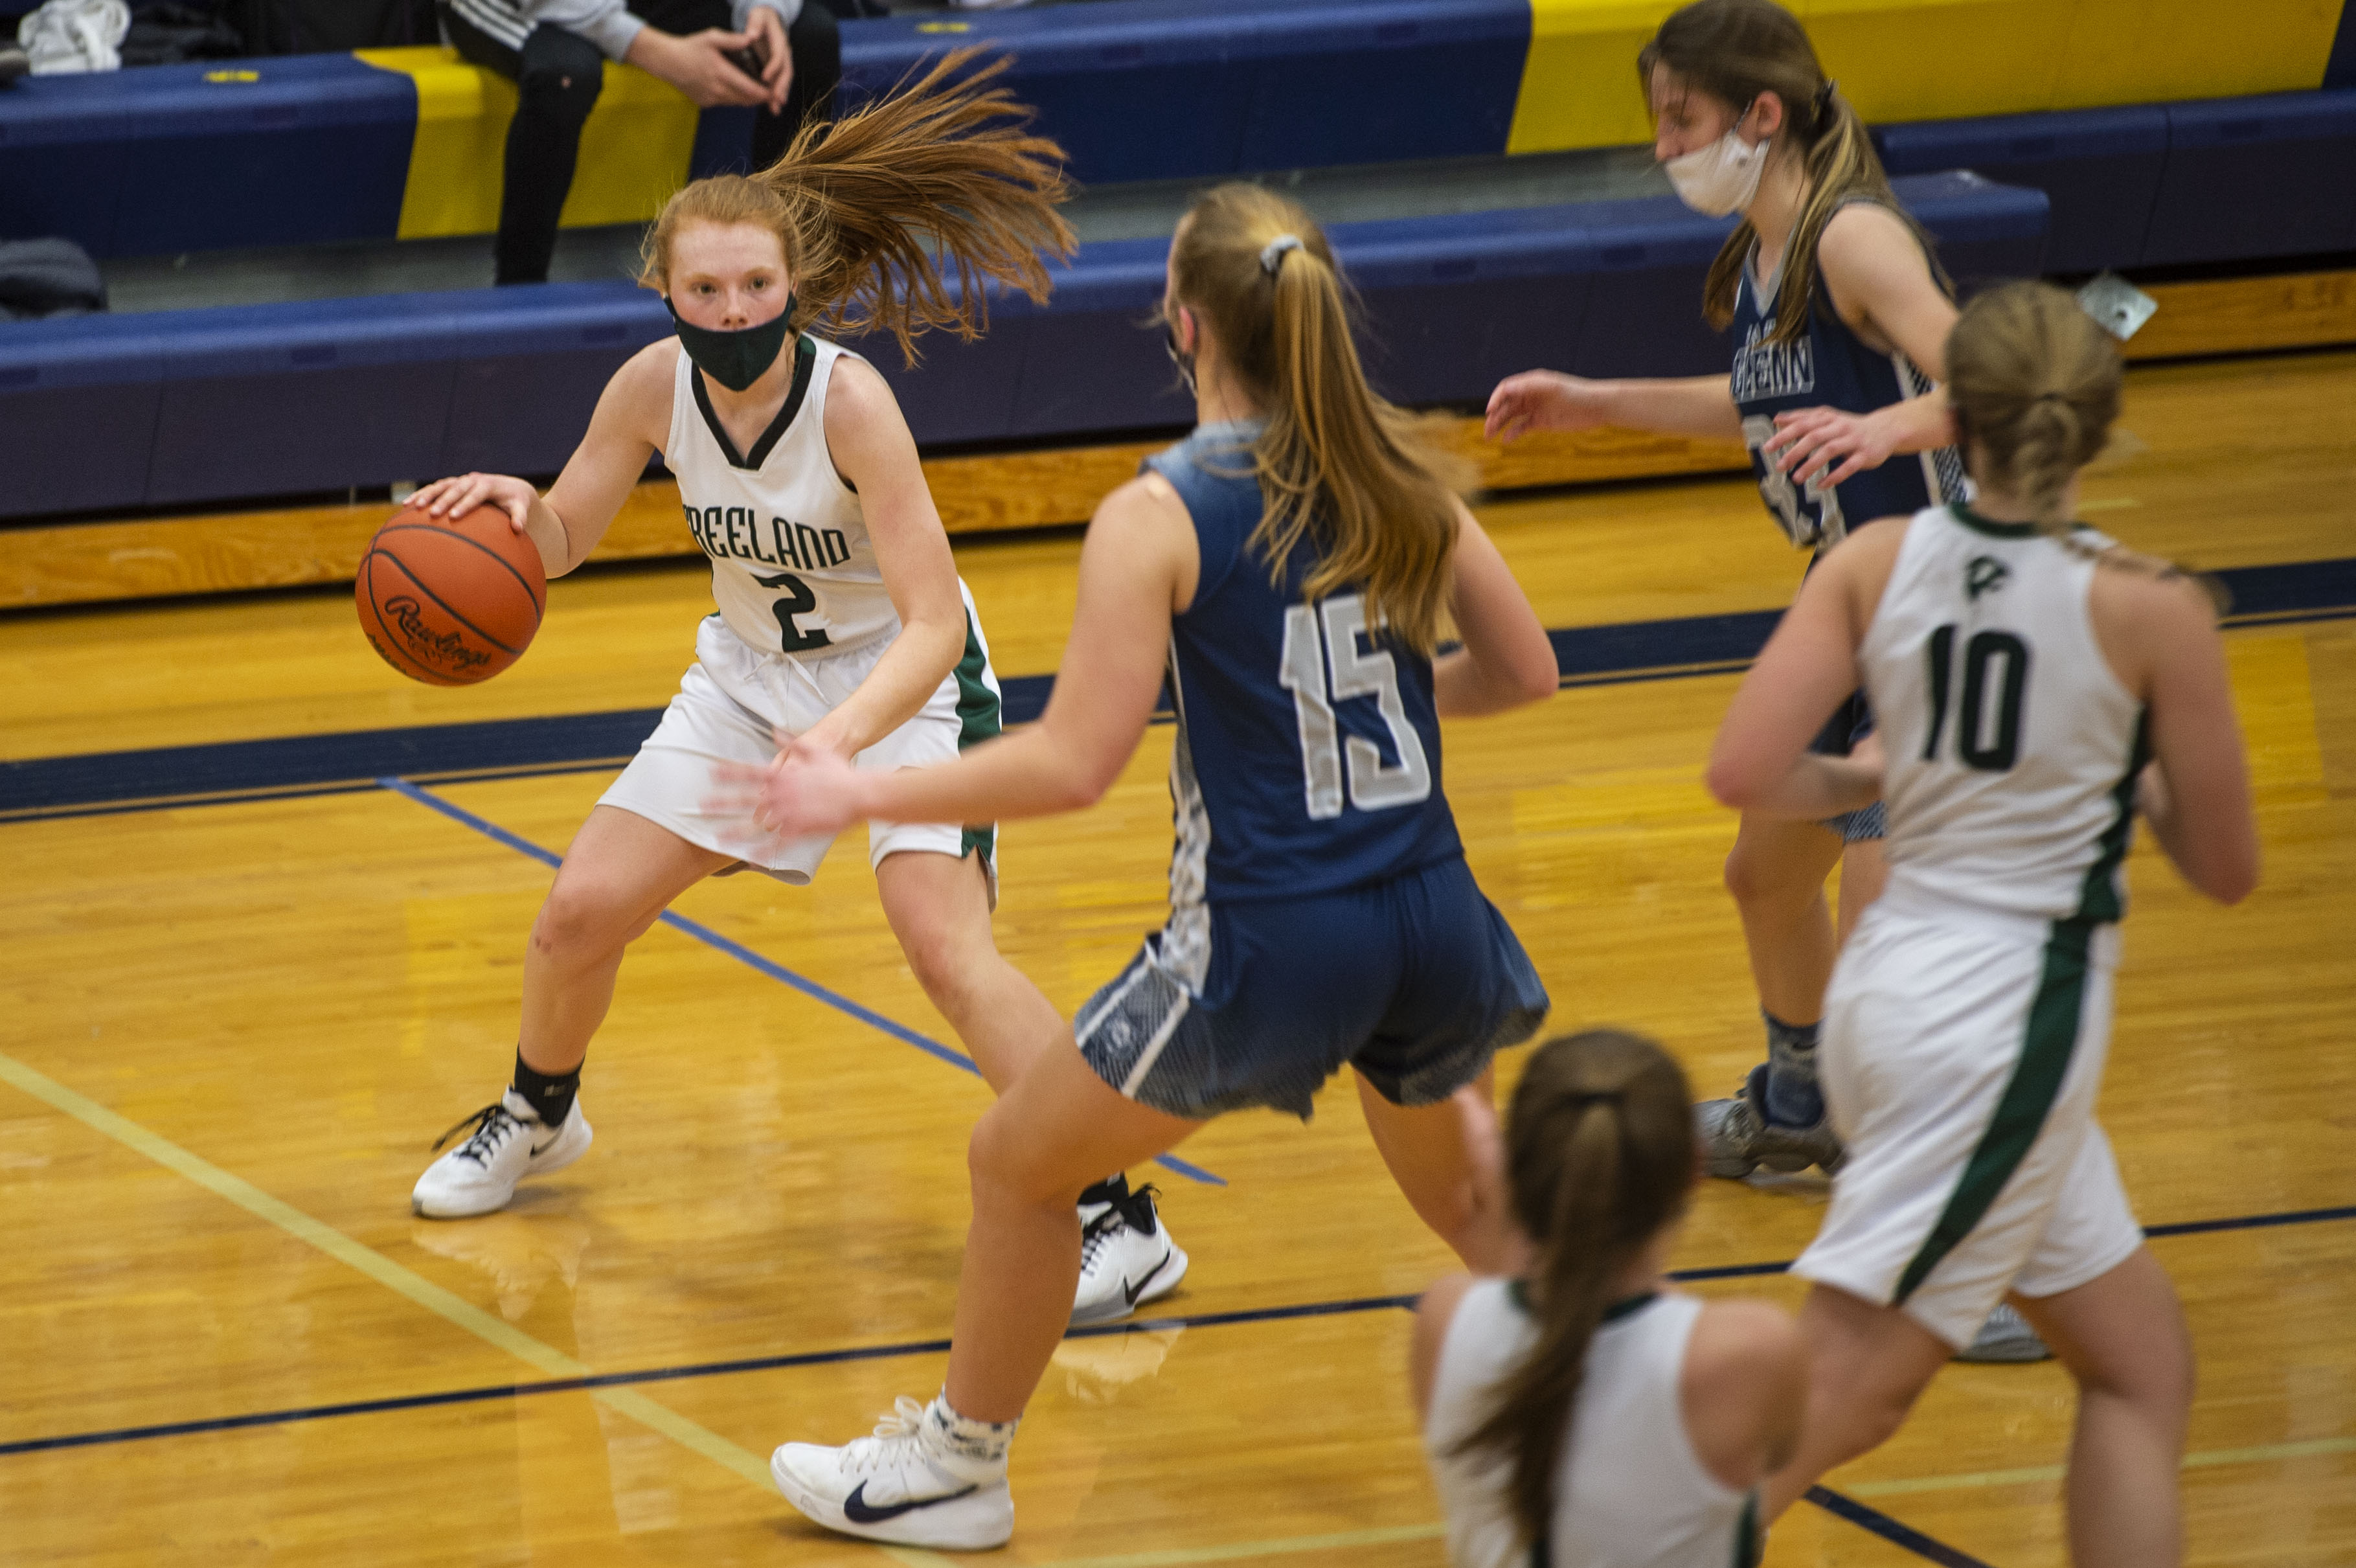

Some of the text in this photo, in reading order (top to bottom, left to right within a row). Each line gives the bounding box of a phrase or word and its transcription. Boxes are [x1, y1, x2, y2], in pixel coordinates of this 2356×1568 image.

[749, 573, 834, 653] 2
[1279, 593, 1431, 821] 15
[1921, 622, 2031, 773] 10
